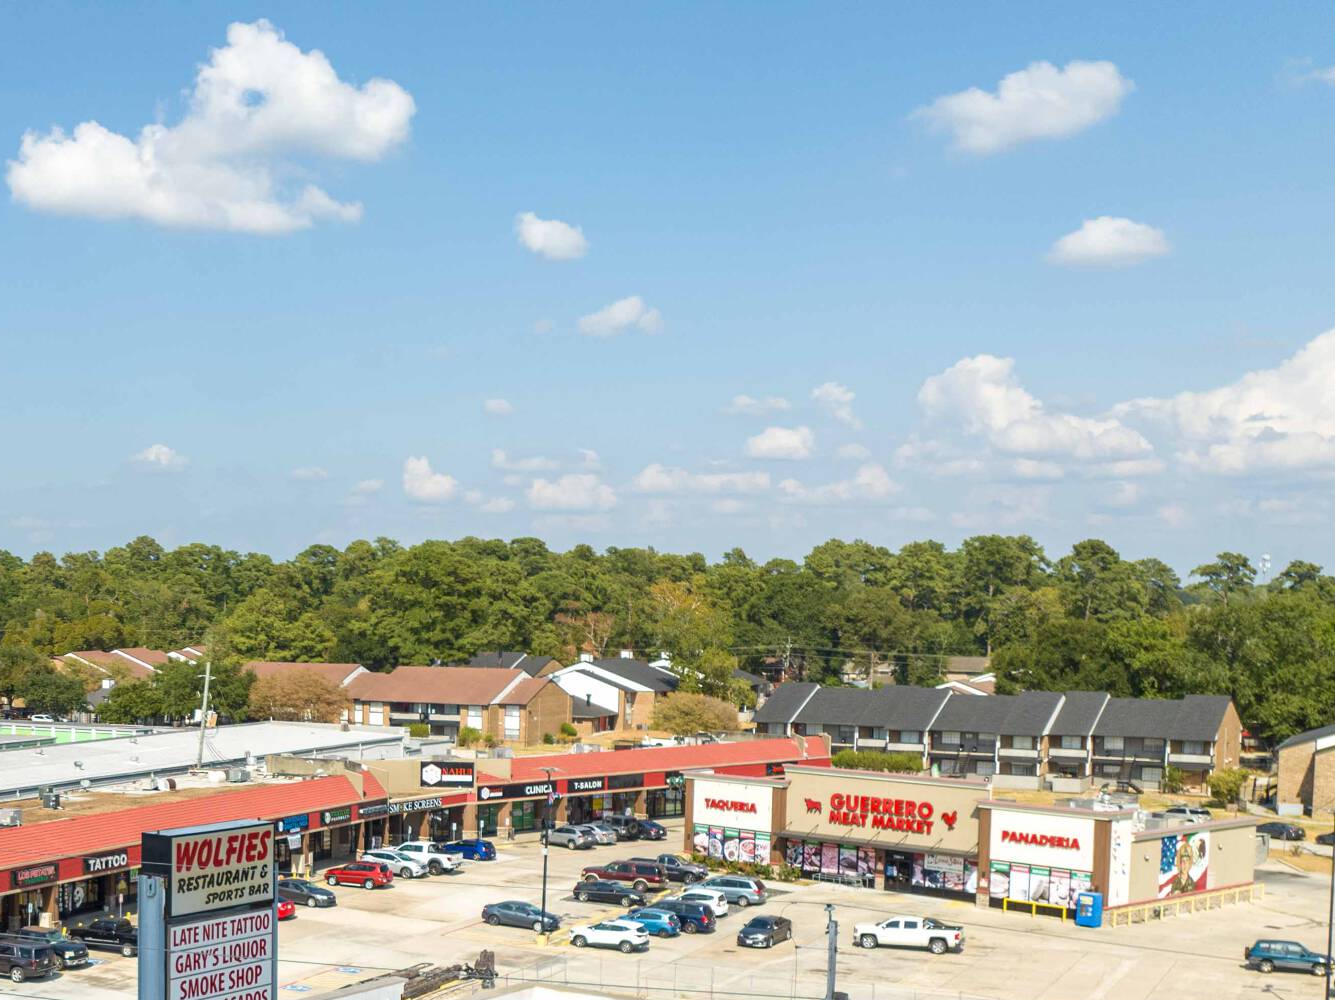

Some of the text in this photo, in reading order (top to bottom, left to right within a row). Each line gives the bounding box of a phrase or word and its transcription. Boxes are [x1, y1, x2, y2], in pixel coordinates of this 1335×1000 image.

[525, 784, 553, 794] CLINICA
[574, 780, 602, 790] T-SALON
[414, 797, 442, 810] SCREENS
[704, 798, 758, 814] TAQUERIA
[830, 793, 934, 820] GUERRERO
[829, 810, 934, 835] MEAT MARKET
[175, 830, 272, 873] WOLFIES
[1001, 830, 1081, 851] PANADERIA
[88, 854, 127, 872] TATTOO
[177, 864, 268, 894] RESTAURANT &
[205, 882, 270, 905] SPORTS BAR
[173, 913, 270, 947] LATE NITE TATTOO
[175, 938, 267, 974] GARY'S LIQUOR
[180, 964, 262, 1000] SMOKE SHOP
